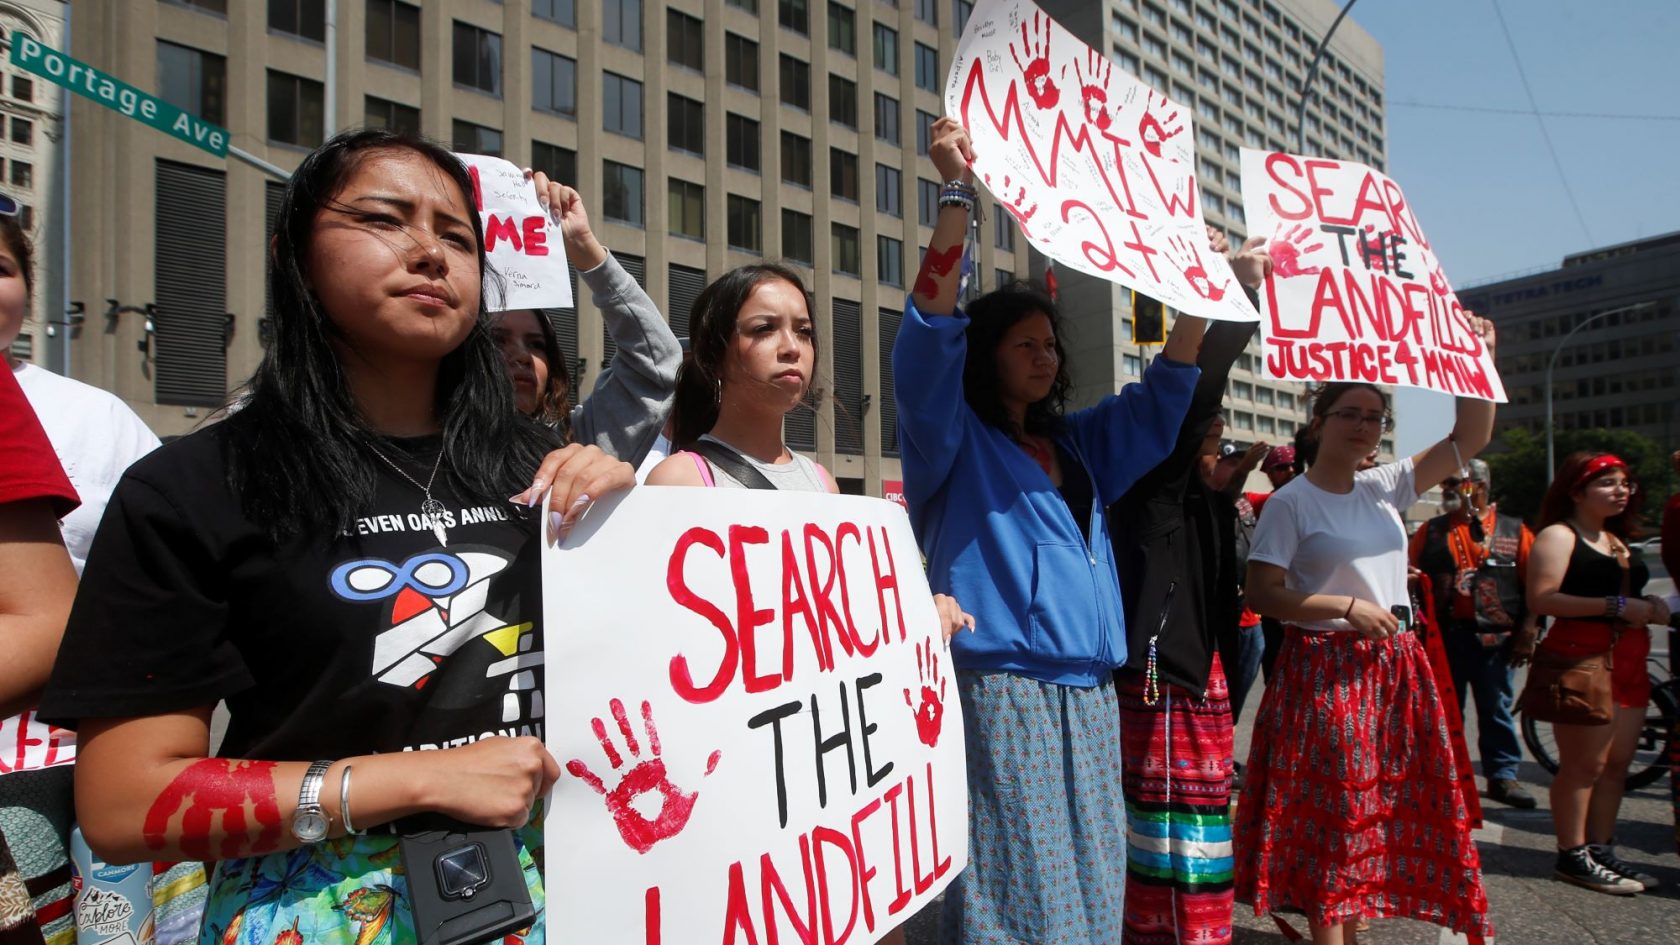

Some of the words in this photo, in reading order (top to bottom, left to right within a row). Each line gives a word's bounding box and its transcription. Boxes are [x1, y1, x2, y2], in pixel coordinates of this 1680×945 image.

[19, 37, 157, 119] Portage
[173, 113, 223, 150] Ave
[960, 56, 1195, 220] MMIW
[485, 213, 549, 256] ME
[1320, 224, 1414, 280] THE
[1265, 266, 1483, 358] LANDFILLS
[1493, 285, 1547, 305] TETRA
[1552, 274, 1603, 296] TECH
[1266, 337, 1398, 384] JUSTICE
[1420, 347, 1496, 401] MMIW
[344, 514, 405, 537] EVEN
[407, 511, 456, 532] OAKS
[886, 492, 904, 502] CIBC
[666, 521, 907, 704] SEARCH
[747, 672, 895, 829] THE
[99, 920, 128, 934] MORE
